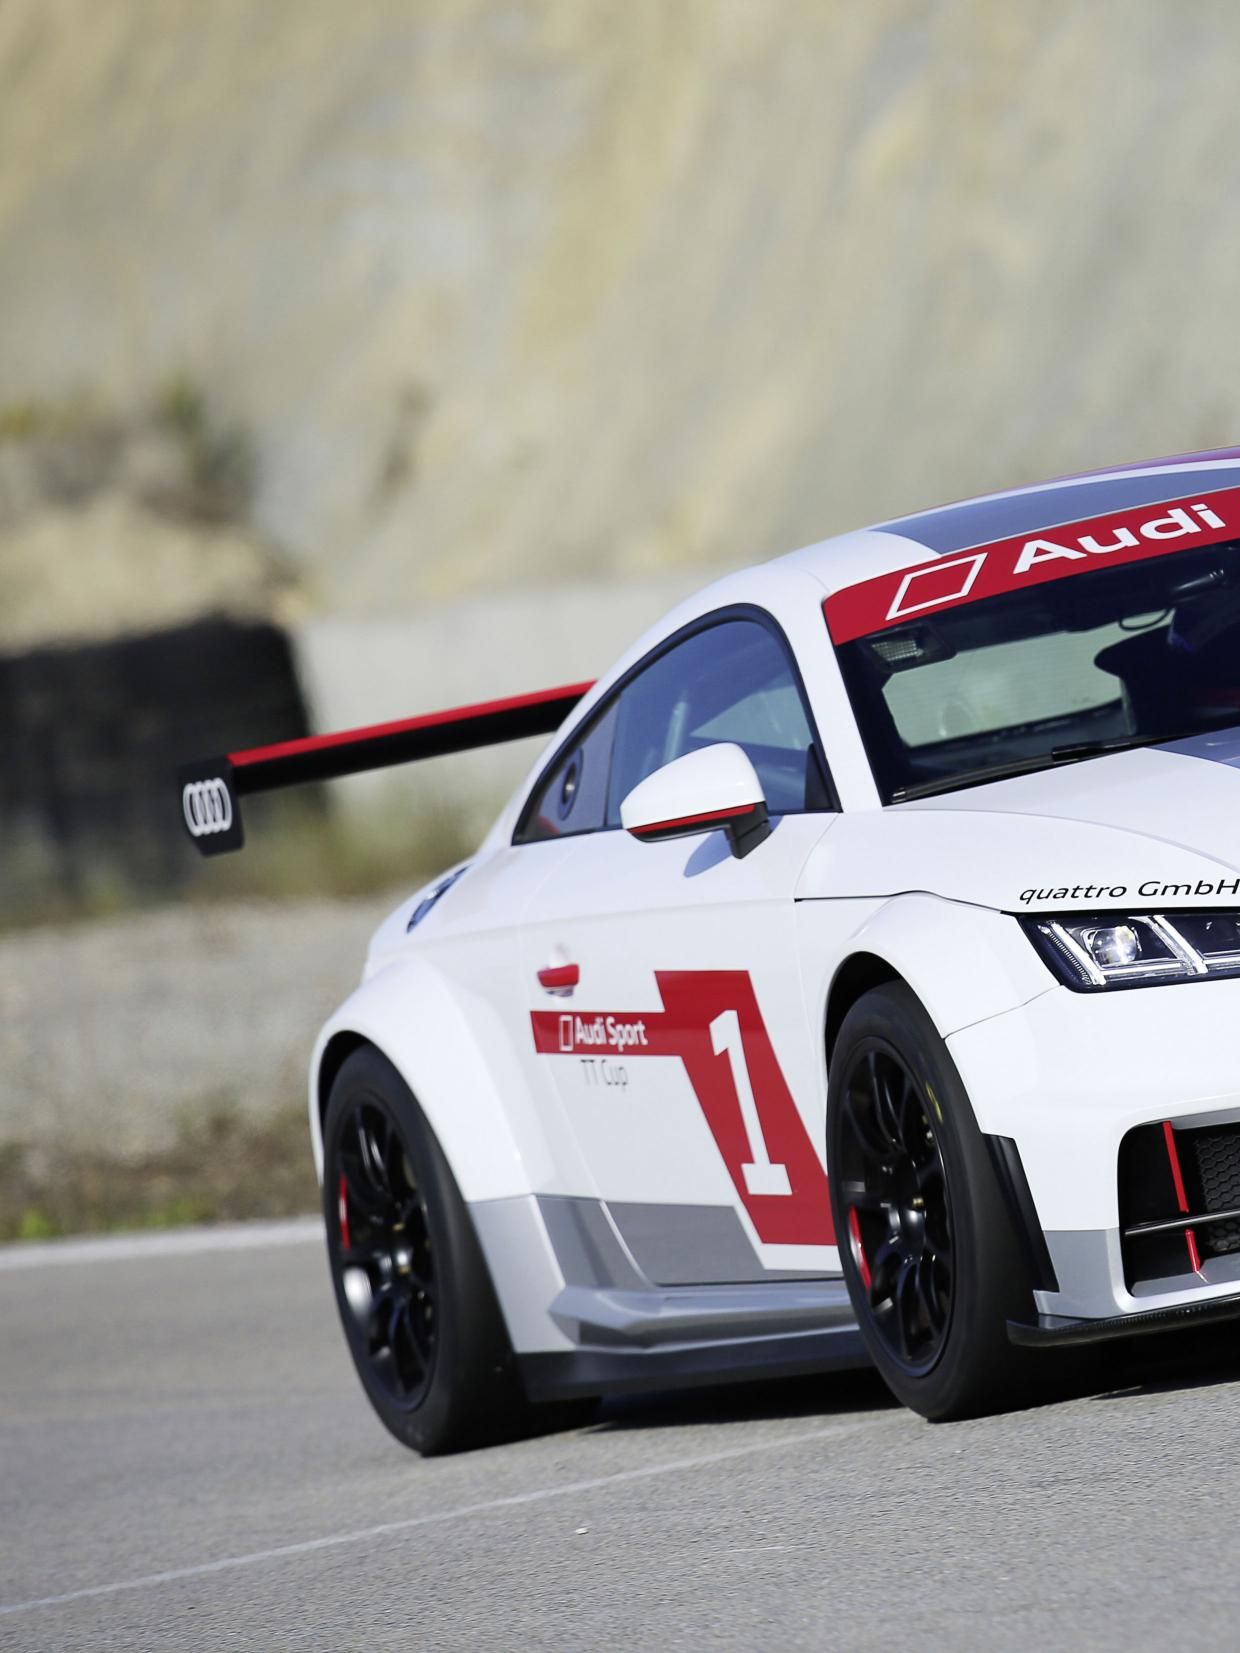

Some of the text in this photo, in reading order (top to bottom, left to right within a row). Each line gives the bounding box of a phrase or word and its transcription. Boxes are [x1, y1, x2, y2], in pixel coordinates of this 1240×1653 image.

[1012, 502, 1227, 575] Audi
[1018, 883, 1127, 905] quattro
[574, 1015, 649, 1053] Audi Sport
[579, 1058, 629, 1093] TT Cup
[708, 1008, 793, 1196] 1
